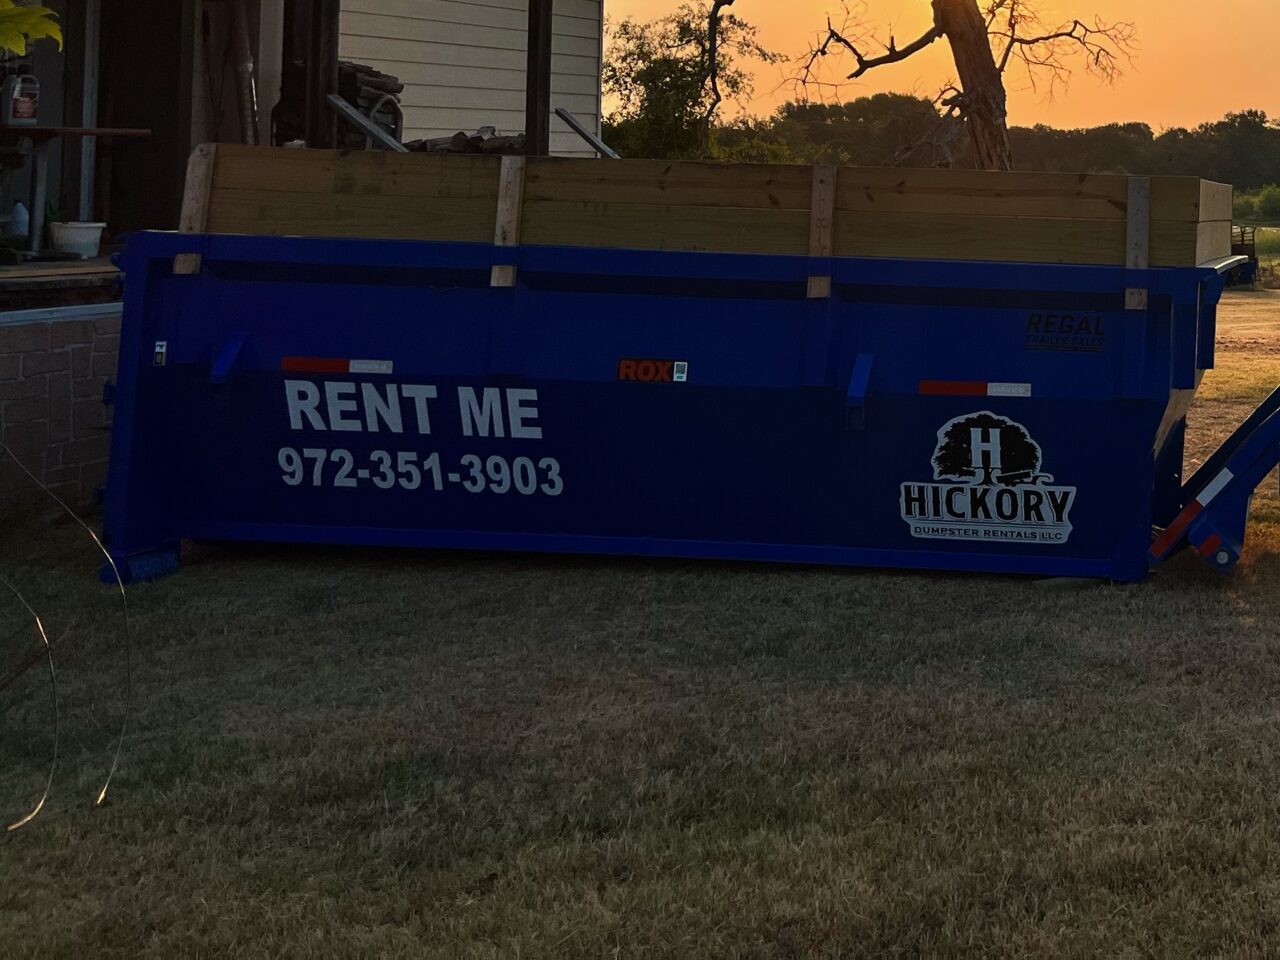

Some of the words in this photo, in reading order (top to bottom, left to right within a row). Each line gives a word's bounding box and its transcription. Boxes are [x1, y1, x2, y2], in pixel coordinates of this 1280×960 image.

[1026, 313, 1105, 336] REGAL
[1025, 335, 1068, 345] TRAILER
[1071, 336, 1104, 346] SALES
[619, 359, 673, 382] ROX
[283, 379, 438, 435] RENT
[457, 386, 543, 440] ME
[969, 427, 1001, 468] H
[277, 446, 564, 497] 972-351-3903
[903, 485, 1071, 523] HICKORY
[914, 526, 980, 537] DUMPSTER
[984, 529, 1038, 539] RENTALS
[1041, 531, 1063, 540] LLC
